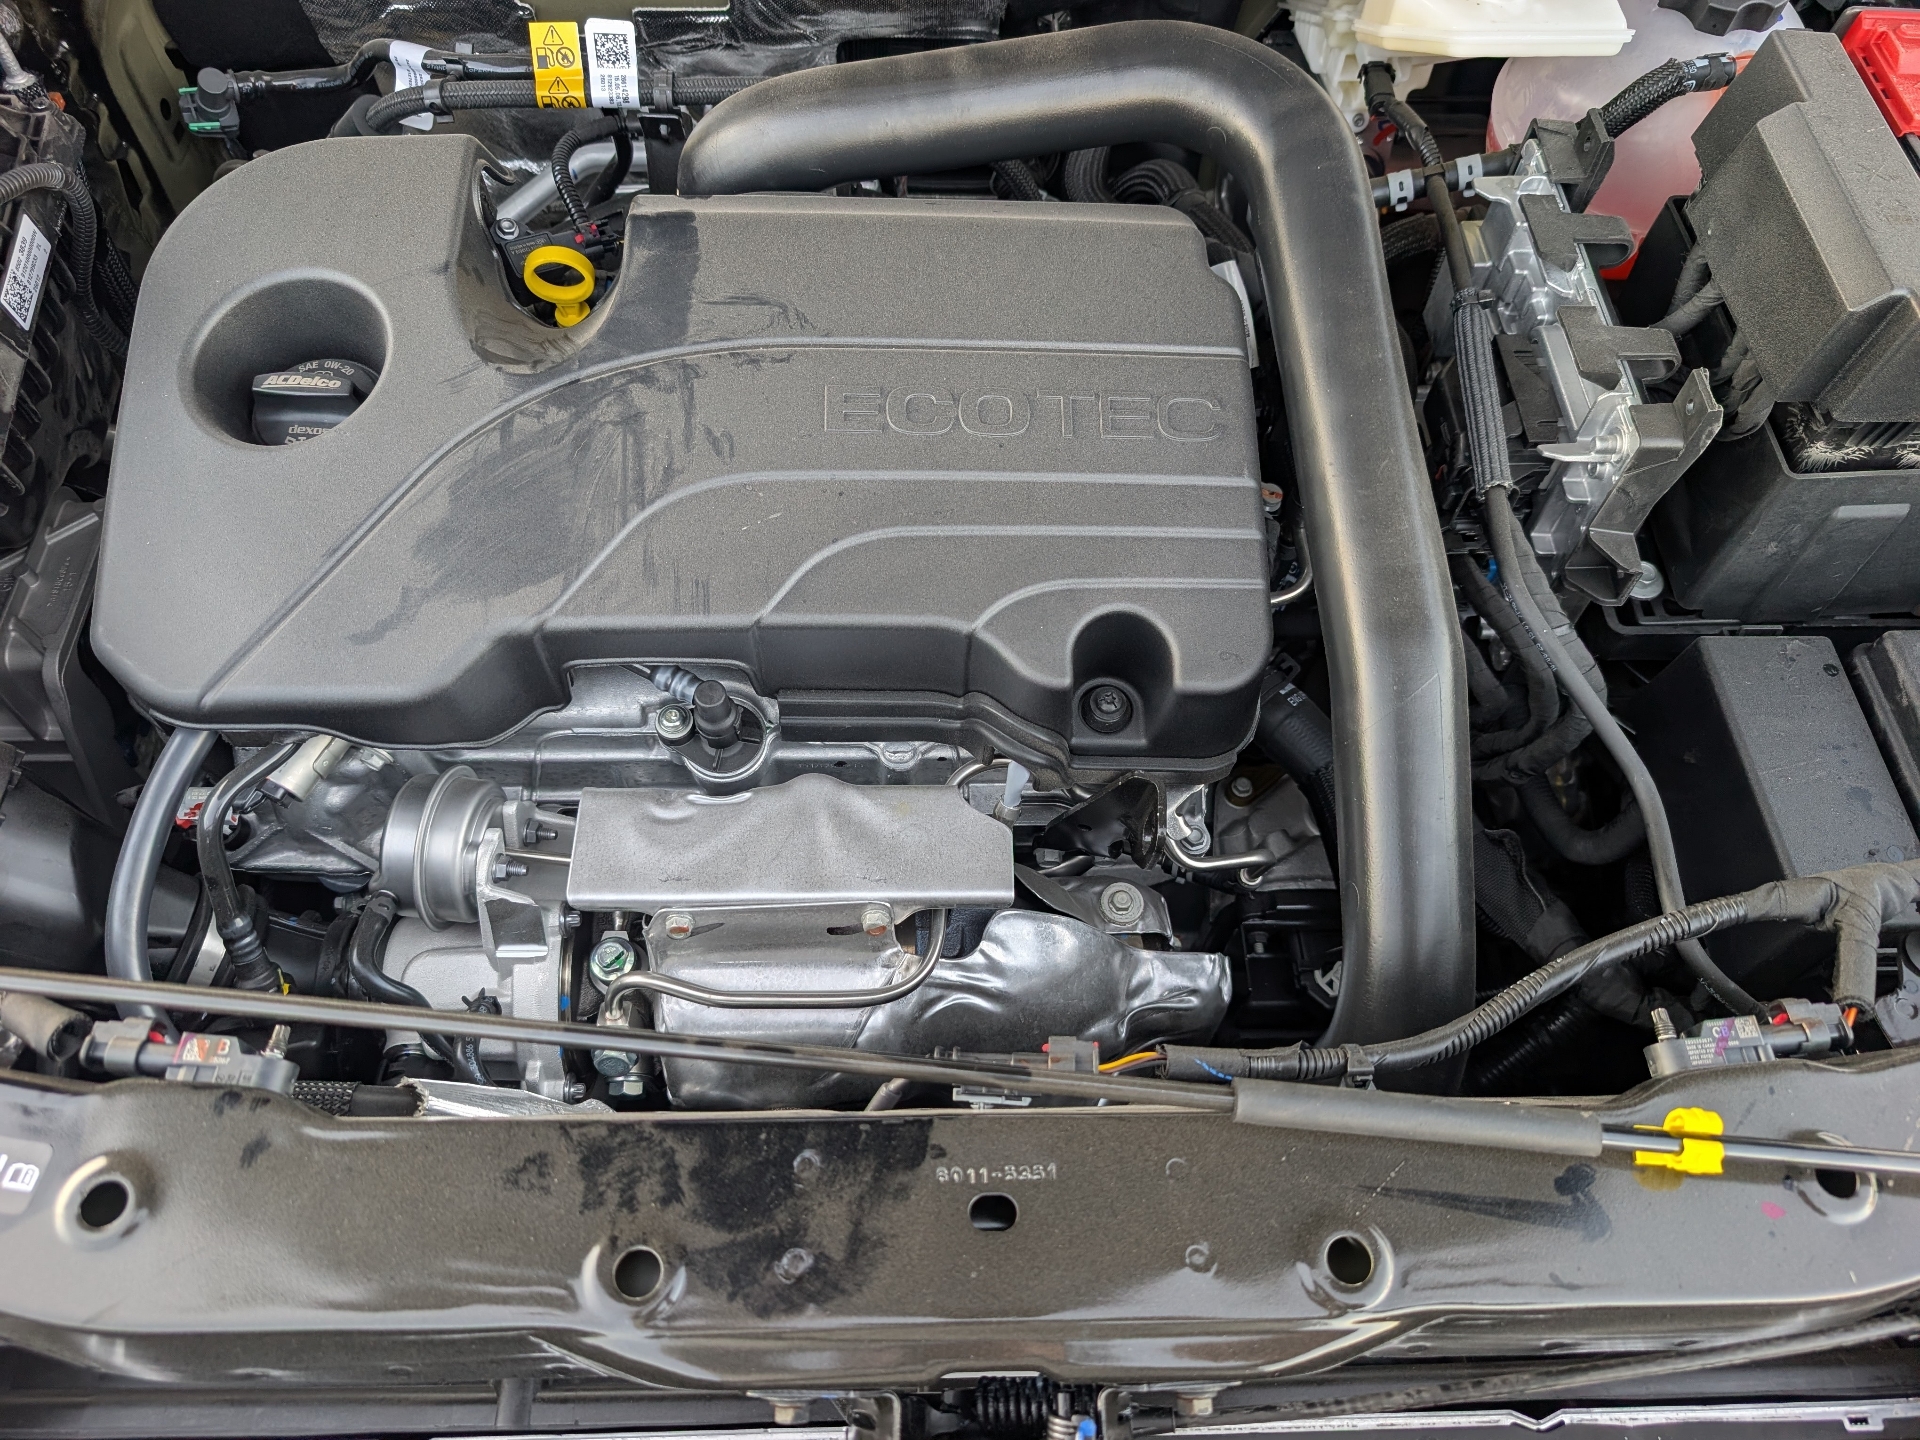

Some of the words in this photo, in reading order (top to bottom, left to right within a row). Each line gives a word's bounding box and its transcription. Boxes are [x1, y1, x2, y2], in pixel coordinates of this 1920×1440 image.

[298, 361, 319, 373] SAE
[324, 360, 355, 376] 0W-20
[261, 375, 342, 388] ACDelco
[823, 383, 1223, 443] ECOTEC
